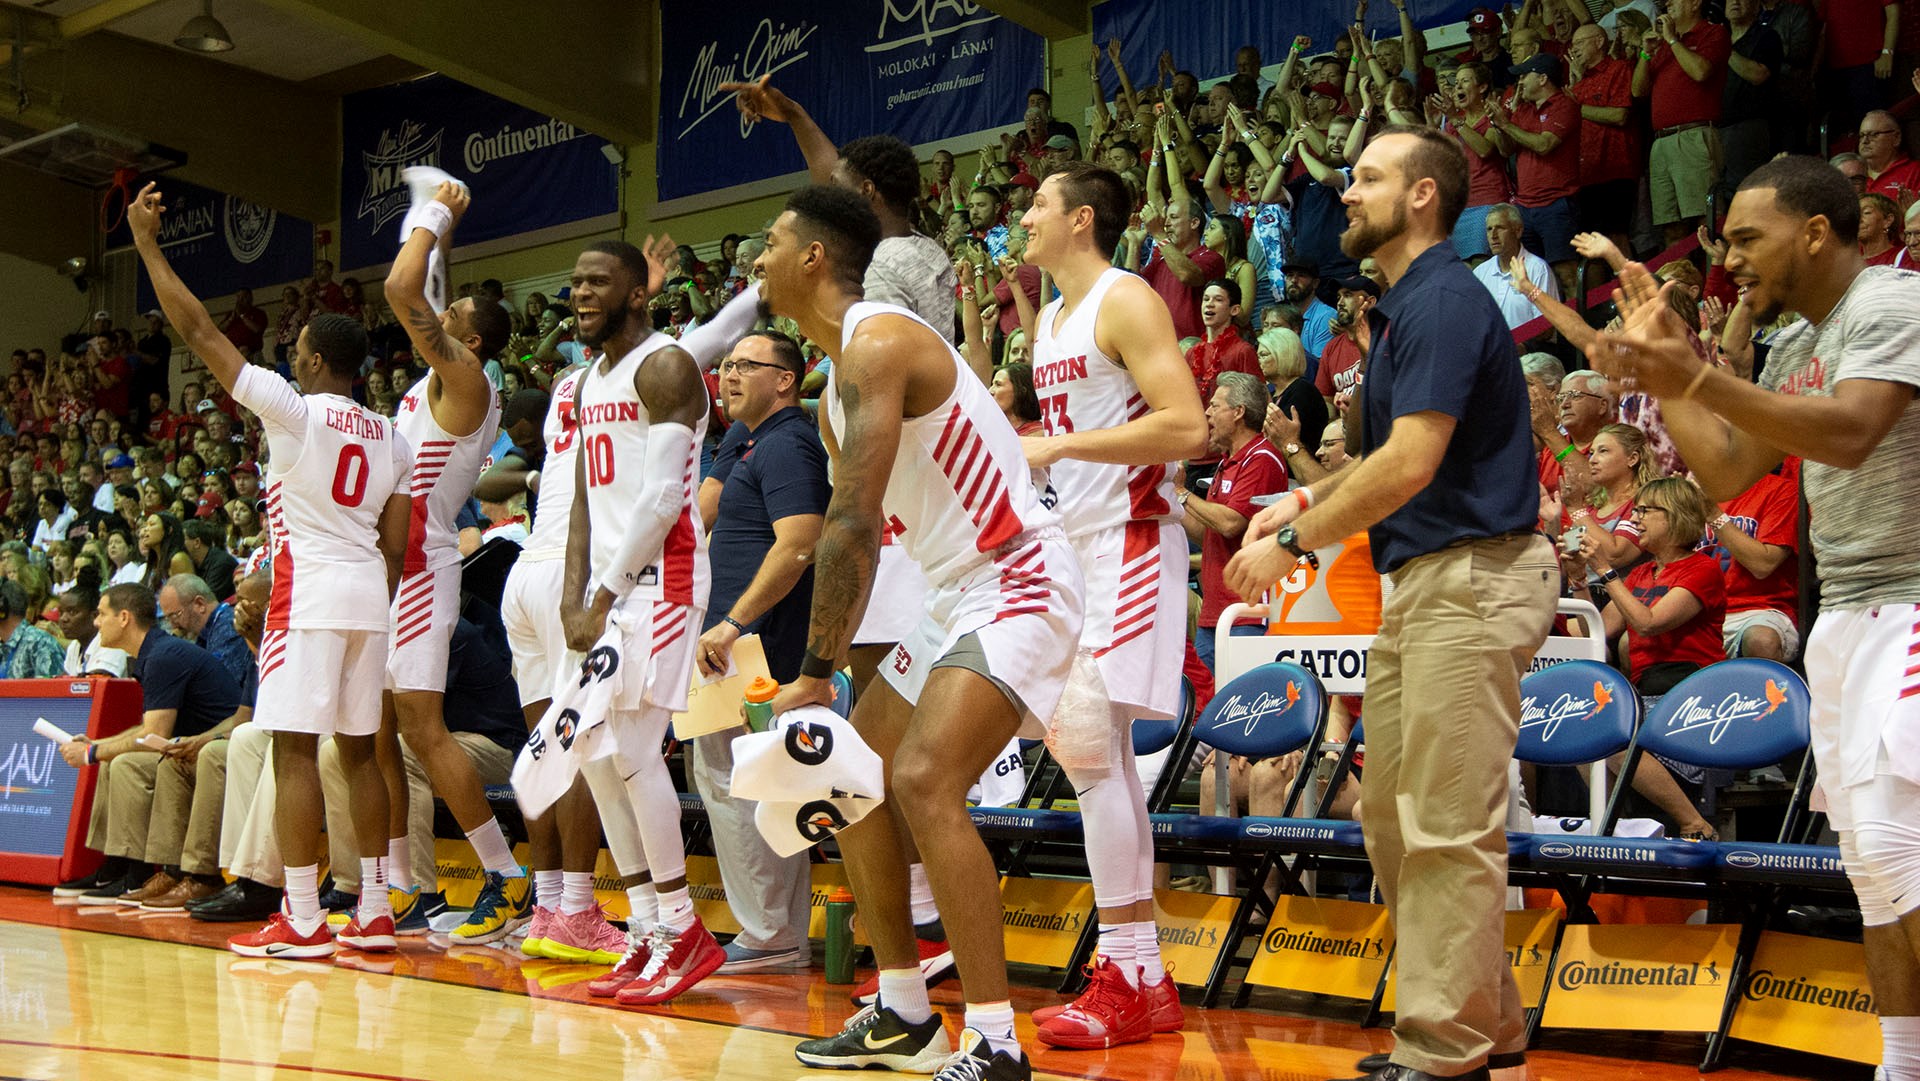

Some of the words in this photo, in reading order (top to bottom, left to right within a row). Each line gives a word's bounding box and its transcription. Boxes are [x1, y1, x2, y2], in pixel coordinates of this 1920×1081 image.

[679, 41, 739, 118] Maui
[740, 18, 818, 139] Jim
[1033, 355, 1088, 390] AYTON
[581, 401, 640, 426] AYTON
[331, 443, 370, 508] 0
[586, 433, 615, 488] 10
[1275, 650, 1367, 679] ATO
[1215, 695, 1251, 721] Maui
[1244, 692, 1287, 737] Jim
[1542, 693, 1595, 742] Jim
[1667, 696, 1713, 727] Maui
[1709, 692, 1767, 744] Jim
[987, 815, 1034, 827] SPECSEATS.COM
[1272, 826, 1335, 839] SPECSEATS.COM
[1575, 845, 1656, 861] SPECSEATS.COM
[1762, 855, 1844, 871] SPECSEATS.COM
[435, 862, 480, 881] ntinental
[1001, 905, 1071, 931] ntinental
[1265, 927, 1371, 958] Continental
[1557, 960, 1699, 991] Continental
[1744, 969, 1879, 1014] Continenta
